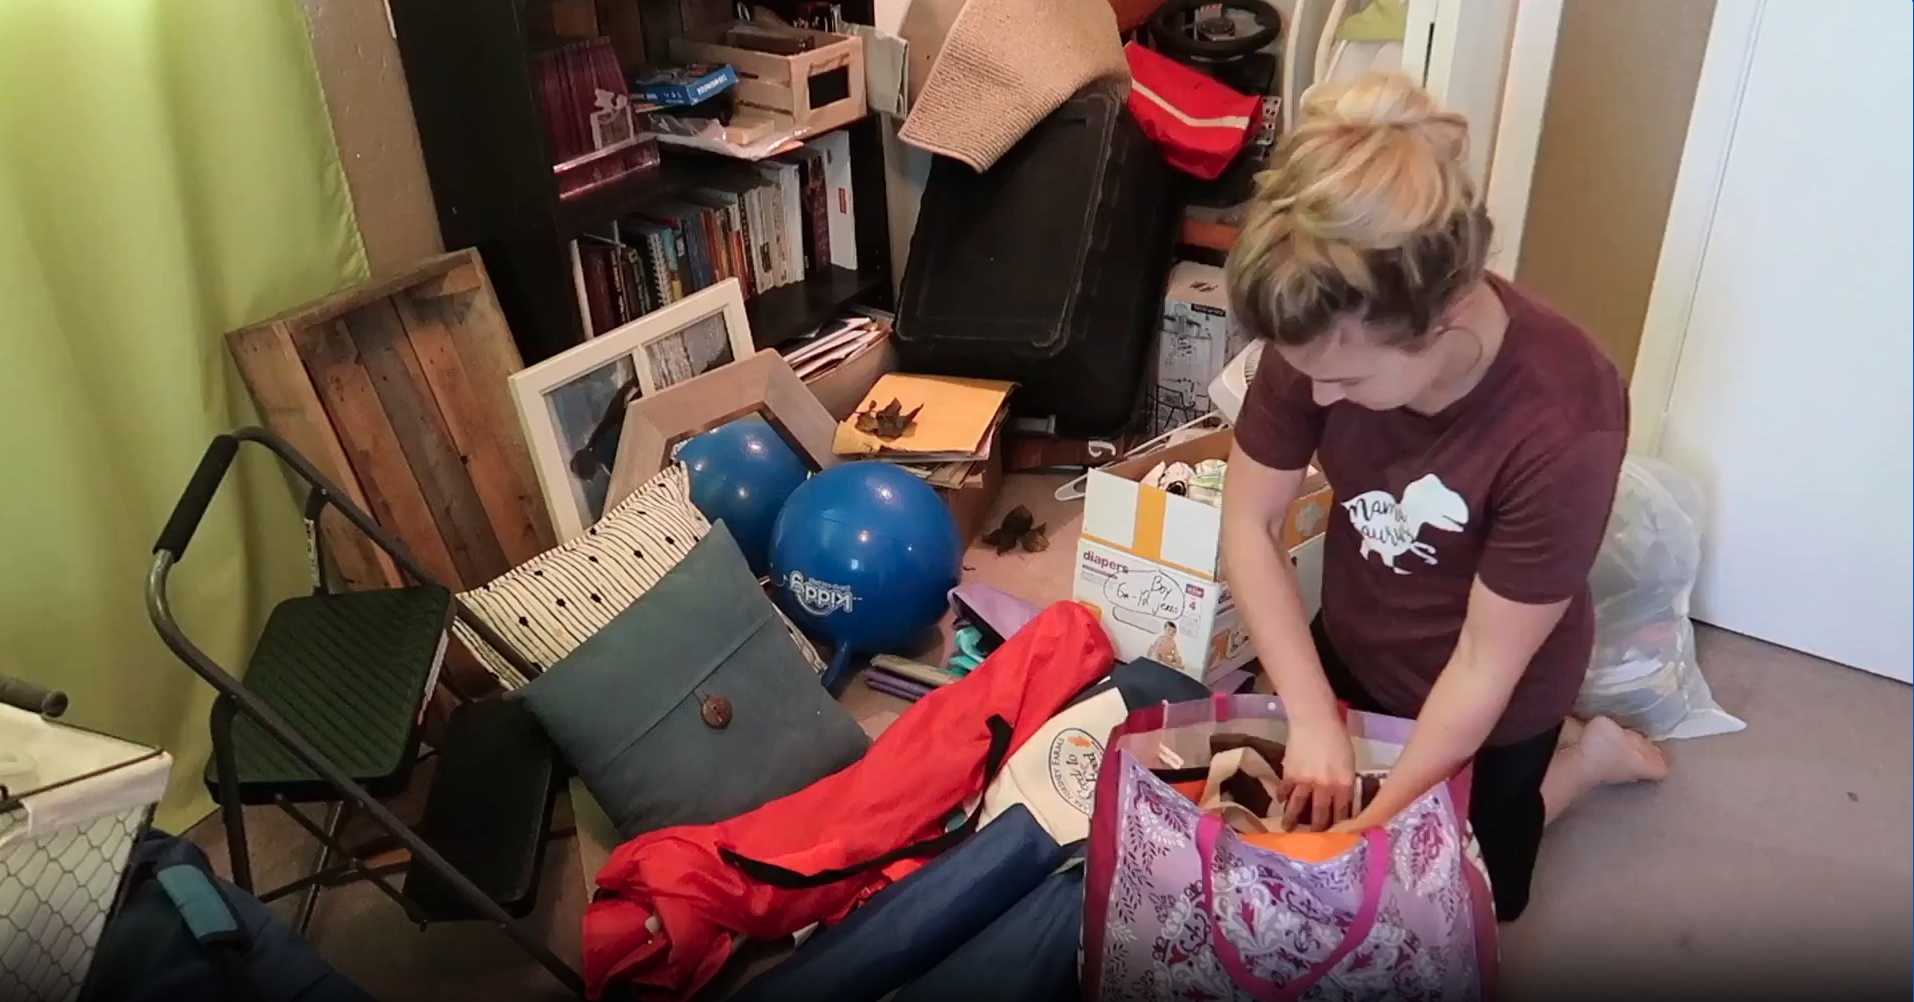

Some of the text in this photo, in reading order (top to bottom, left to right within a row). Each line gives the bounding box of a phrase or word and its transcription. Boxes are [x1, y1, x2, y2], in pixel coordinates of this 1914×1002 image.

[1083, 550, 1130, 574] diapers
[1151, 575, 1173, 601] Boy
[1189, 601, 1197, 611] 4
